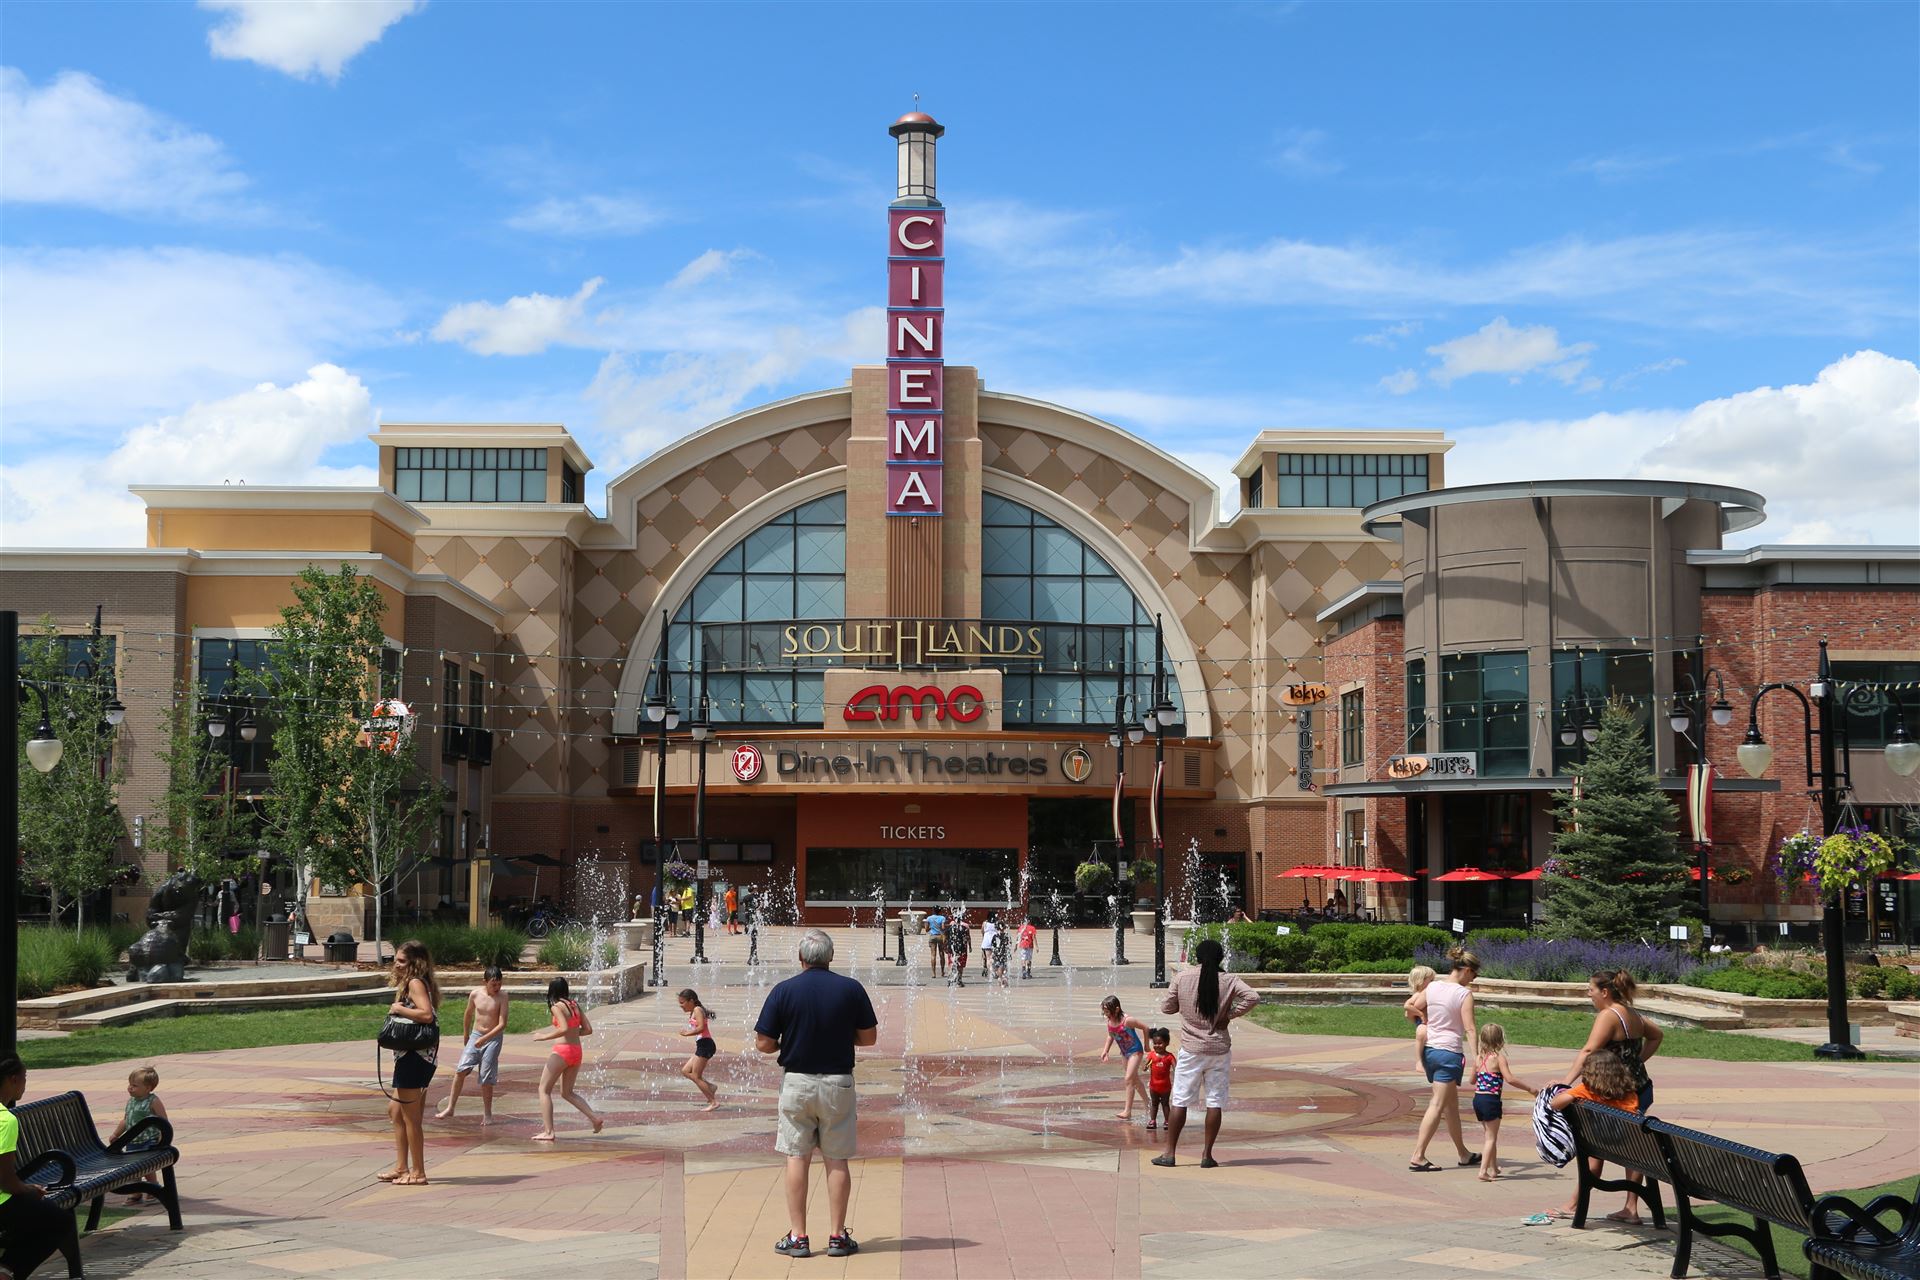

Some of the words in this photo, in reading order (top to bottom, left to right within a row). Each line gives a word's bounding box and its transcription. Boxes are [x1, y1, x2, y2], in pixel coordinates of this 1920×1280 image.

[895, 215, 936, 506] CINEMA
[783, 620, 1044, 665] SOUTHLANDS
[1287, 681, 1326, 705] Tokyo
[776, 750, 896, 776] Dine-In
[900, 749, 1048, 776] Theatres
[1429, 757, 1470, 775] JOE'S
[880, 825, 946, 840] TICKETS
